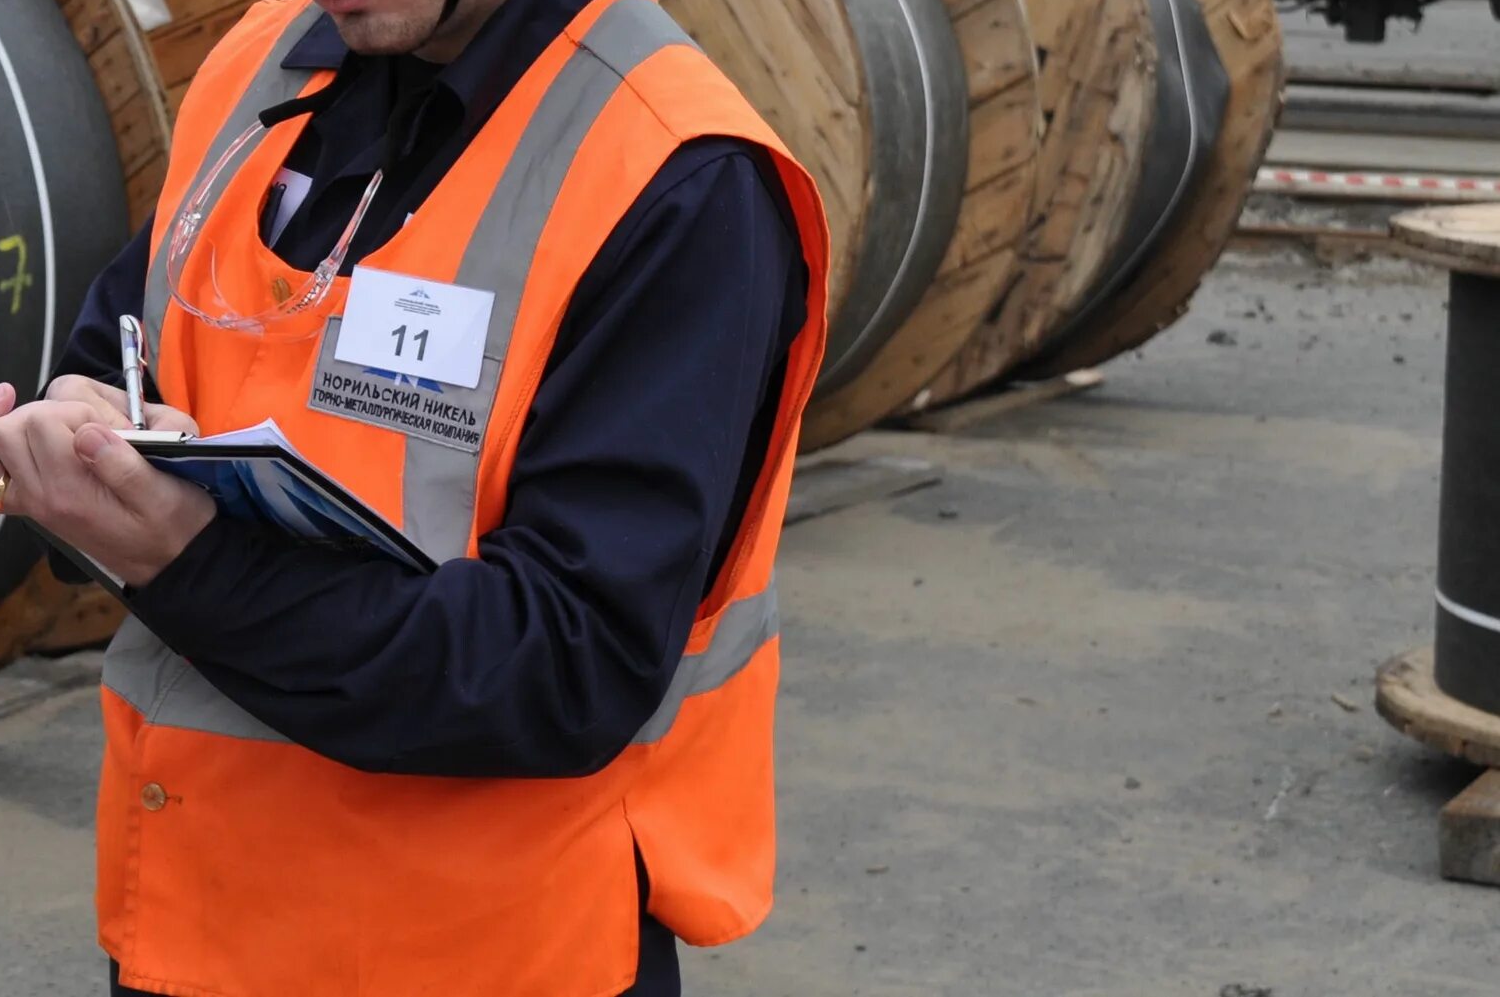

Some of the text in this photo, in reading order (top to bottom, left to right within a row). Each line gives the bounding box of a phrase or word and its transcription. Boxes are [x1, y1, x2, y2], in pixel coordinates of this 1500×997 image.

[390, 324, 430, 362] 11
[313, 389, 480, 446] ГОРНО-МЕТАЛЛУРГИЧЕСКАЯ КОМПАНИЯ
[322, 372, 477, 427] НОРИЛЬСКИЙ НИКЕЛЬ
